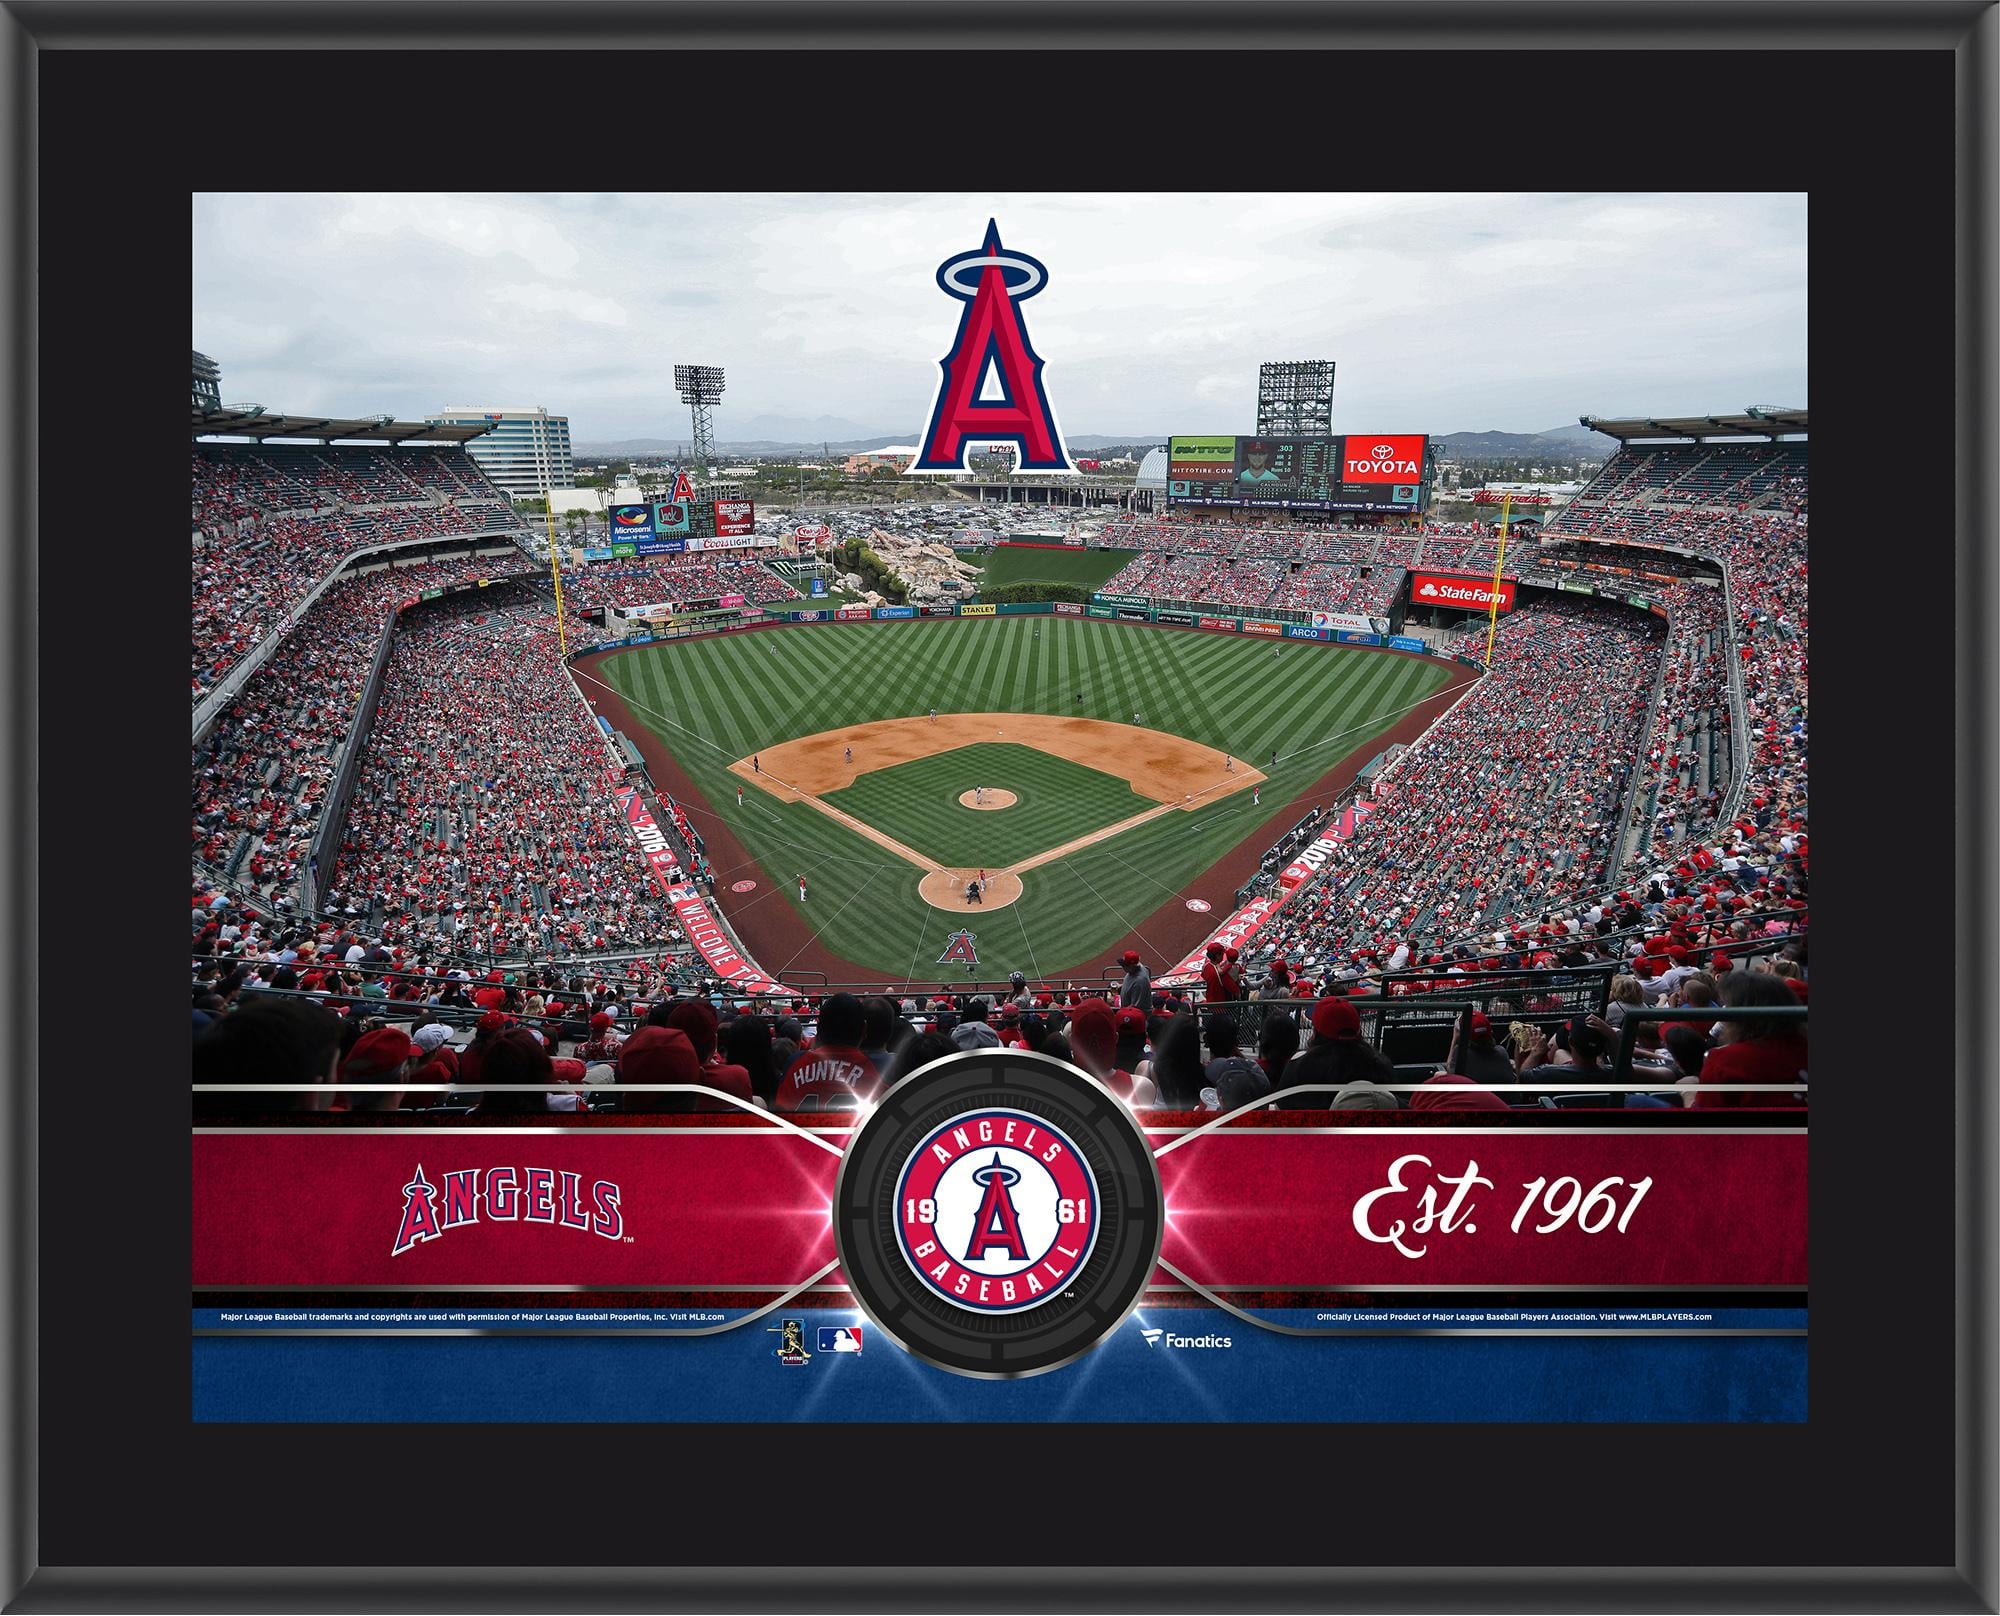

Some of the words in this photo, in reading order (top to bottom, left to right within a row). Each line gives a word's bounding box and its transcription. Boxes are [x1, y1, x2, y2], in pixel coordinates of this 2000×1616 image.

[1174, 446, 1234, 454] NITTO
[1348, 460, 1418, 474] TOYOTA
[615, 526, 651, 534] Microsemi
[703, 538, 729, 549] Coors
[1331, 617, 1360, 626] TOTAL
[1291, 628, 1318, 637] ARCO
[632, 822, 671, 853] 2016
[1292, 837, 1339, 870] 2016
[680, 902, 735, 967] WELCOME
[936, 928, 980, 964] A
[794, 1060, 864, 1088] HUNTER
